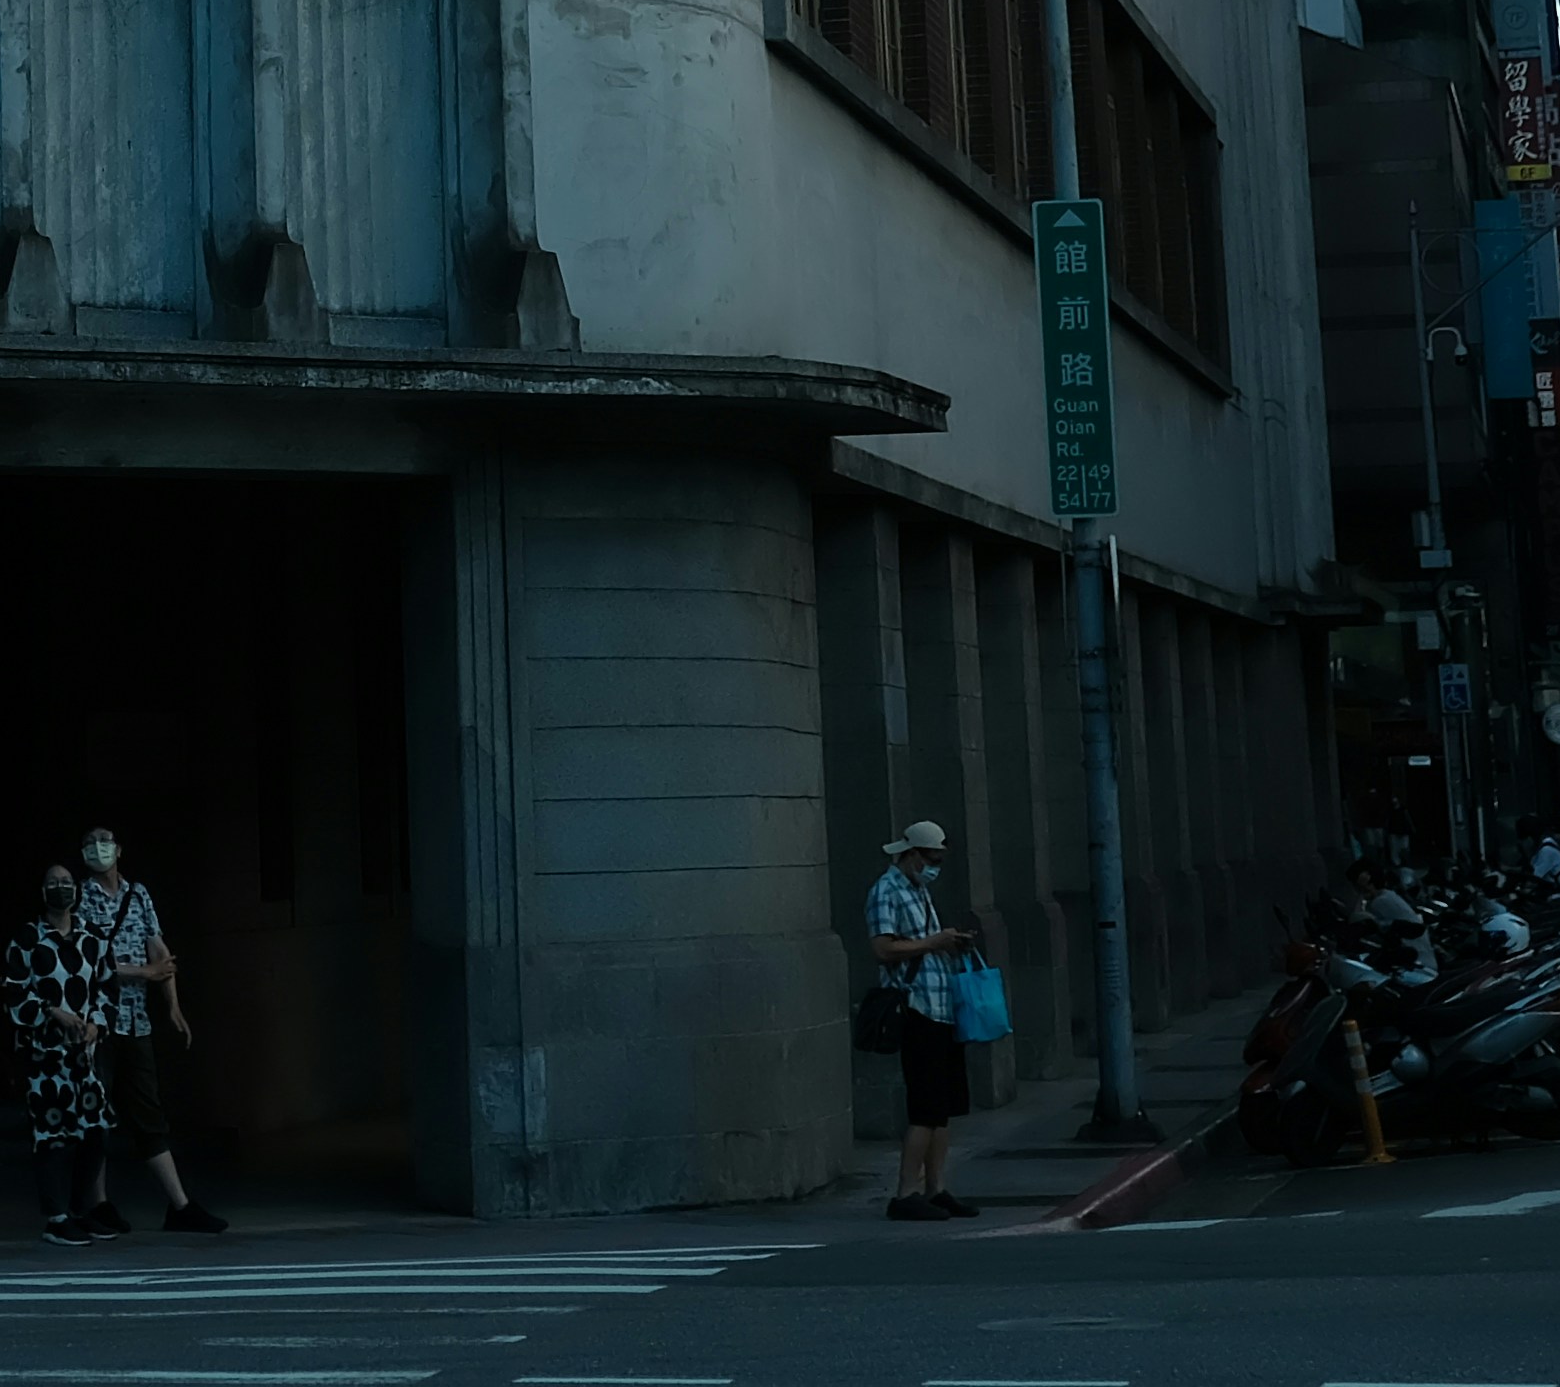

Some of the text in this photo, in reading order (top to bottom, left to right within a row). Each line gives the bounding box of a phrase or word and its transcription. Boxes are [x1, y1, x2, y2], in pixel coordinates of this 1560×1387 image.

[1504, 60, 1538, 162] 留學家
[1053, 240, 1093, 387] 館前路
[1053, 398, 1099, 413] Guan
[1055, 419, 1096, 435] Qian
[1056, 442, 1084, 457] Rd.
[1057, 464, 1111, 481] 22 49
[1059, 492, 1111, 509] 54 77
